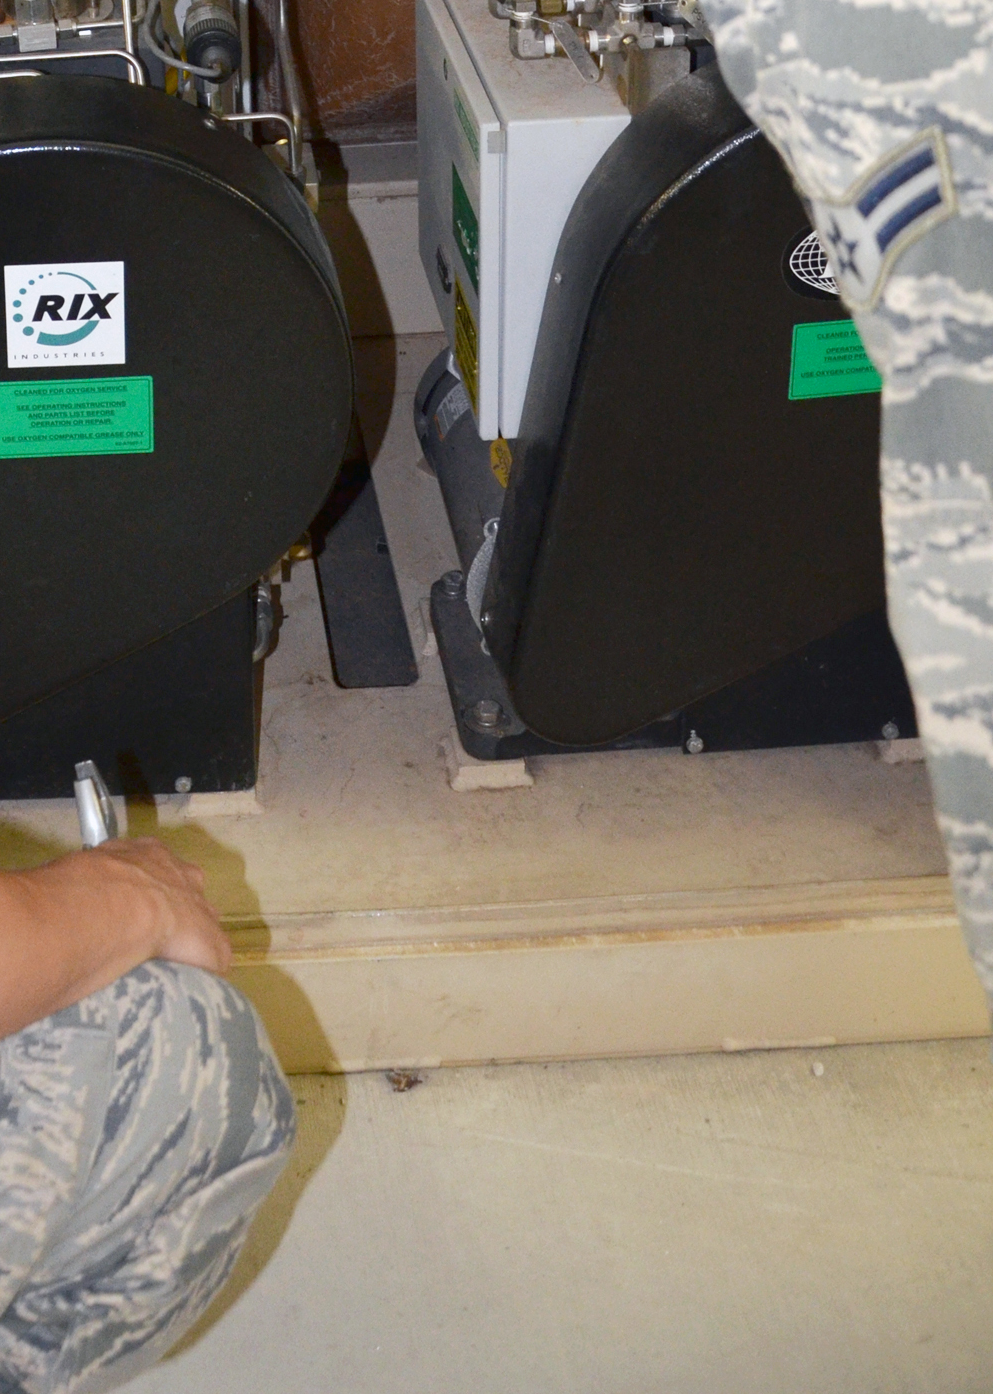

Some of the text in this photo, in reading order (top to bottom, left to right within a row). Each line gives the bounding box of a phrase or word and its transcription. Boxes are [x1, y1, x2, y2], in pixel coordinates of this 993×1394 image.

[32, 292, 119, 322] RIX
[817, 331, 850, 340] CLEANED
[13, 351, 106, 360] INDUSTRIES
[824, 354, 853, 362] TRAINED
[816, 369, 844, 377] OXYGEN
[66, 386, 96, 394] OXYGEN
[74, 401, 127, 409] INSTRUCTIONS
[31, 420, 71, 428] OPERATION
[49, 433, 94, 441] COMPATIBLE
[95, 431, 124, 439] GREASE
